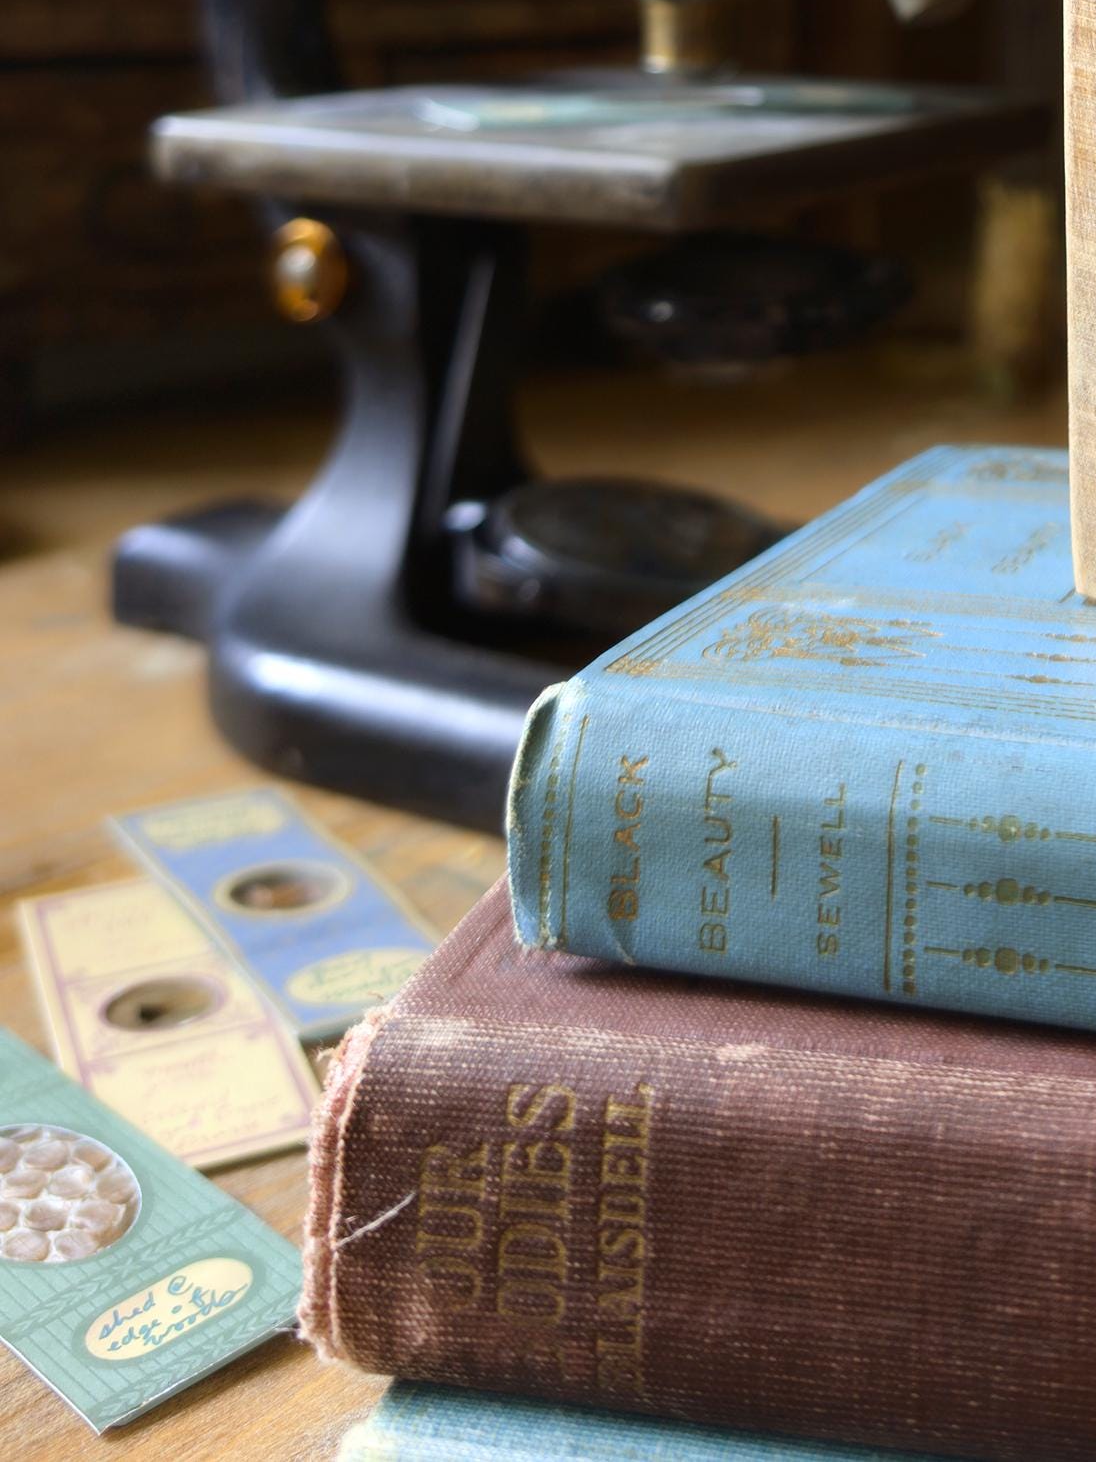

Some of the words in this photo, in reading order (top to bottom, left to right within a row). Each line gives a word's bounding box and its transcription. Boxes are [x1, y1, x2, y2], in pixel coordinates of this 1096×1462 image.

[607, 754, 649, 922] BLACK
[699, 747, 738, 955] BEAUTY
[815, 782, 846, 956] SEWELL
